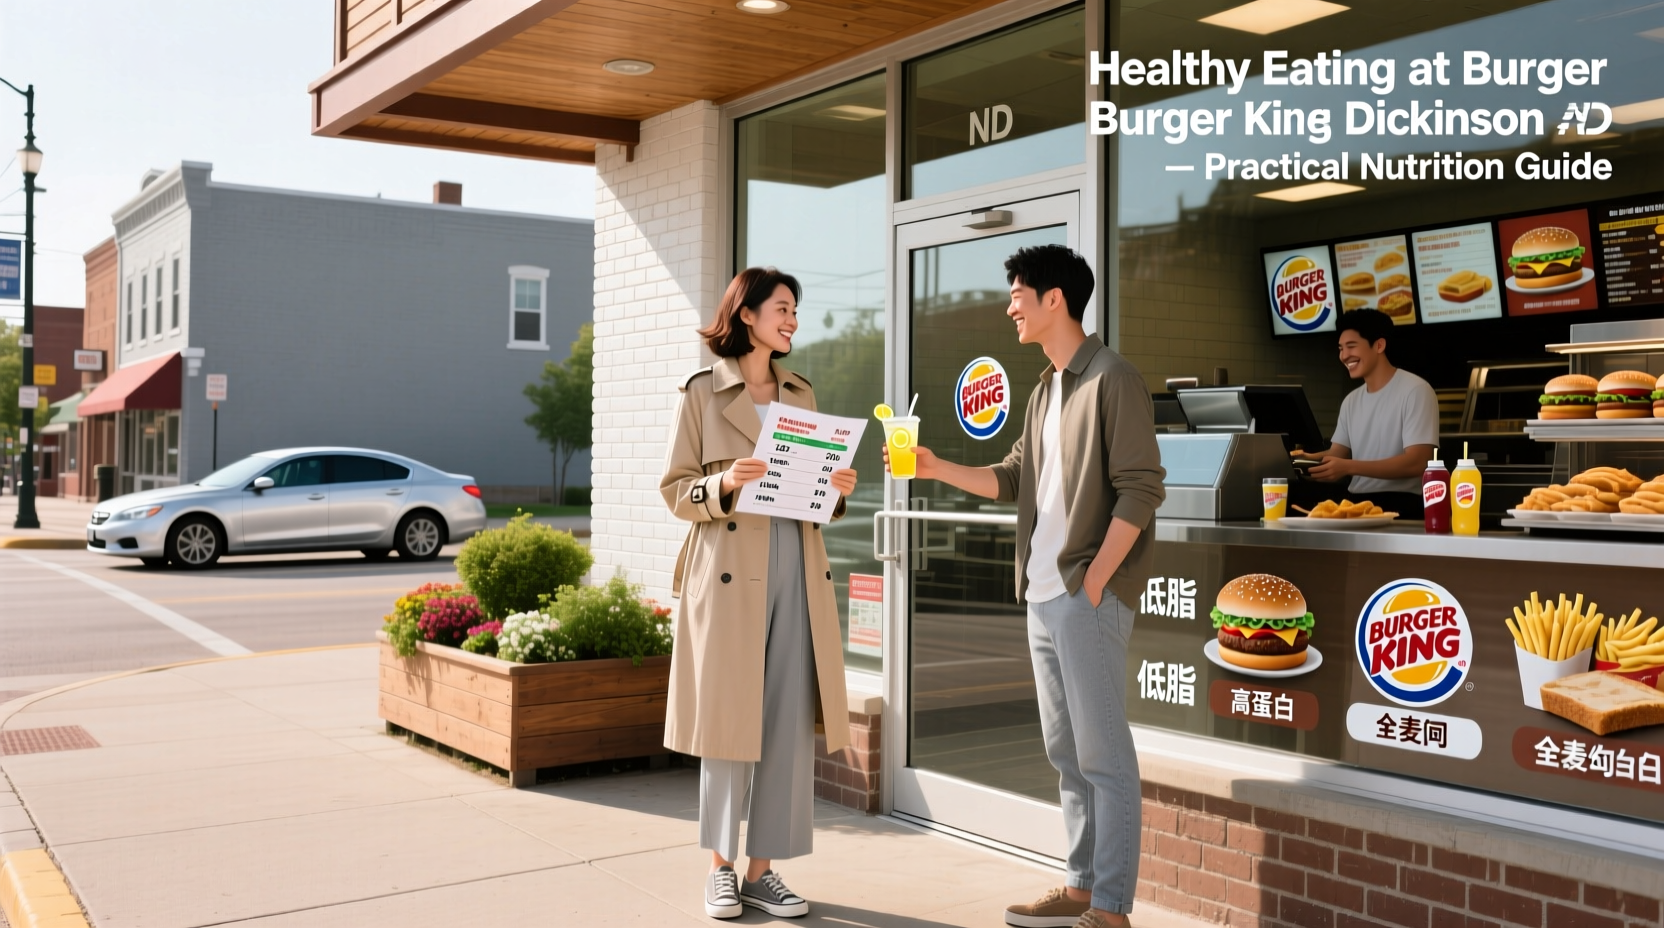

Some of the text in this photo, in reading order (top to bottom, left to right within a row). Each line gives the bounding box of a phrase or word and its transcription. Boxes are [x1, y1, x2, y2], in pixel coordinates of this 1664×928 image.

[969, 104, 1013, 146] ND
[1277, 268, 1325, 299] BURGER
[1279, 282, 1327, 317] KING
[962, 373, 1003, 401] BURGER
[963, 385, 1004, 419] KING
[1140, 577, 1197, 620] 低脂
[1369, 606, 1458, 645] BURGER
[1371, 628, 1461, 676] KING
[1137, 659, 1197, 707] 低脂
[1231, 688, 1294, 722] 高蛋白
